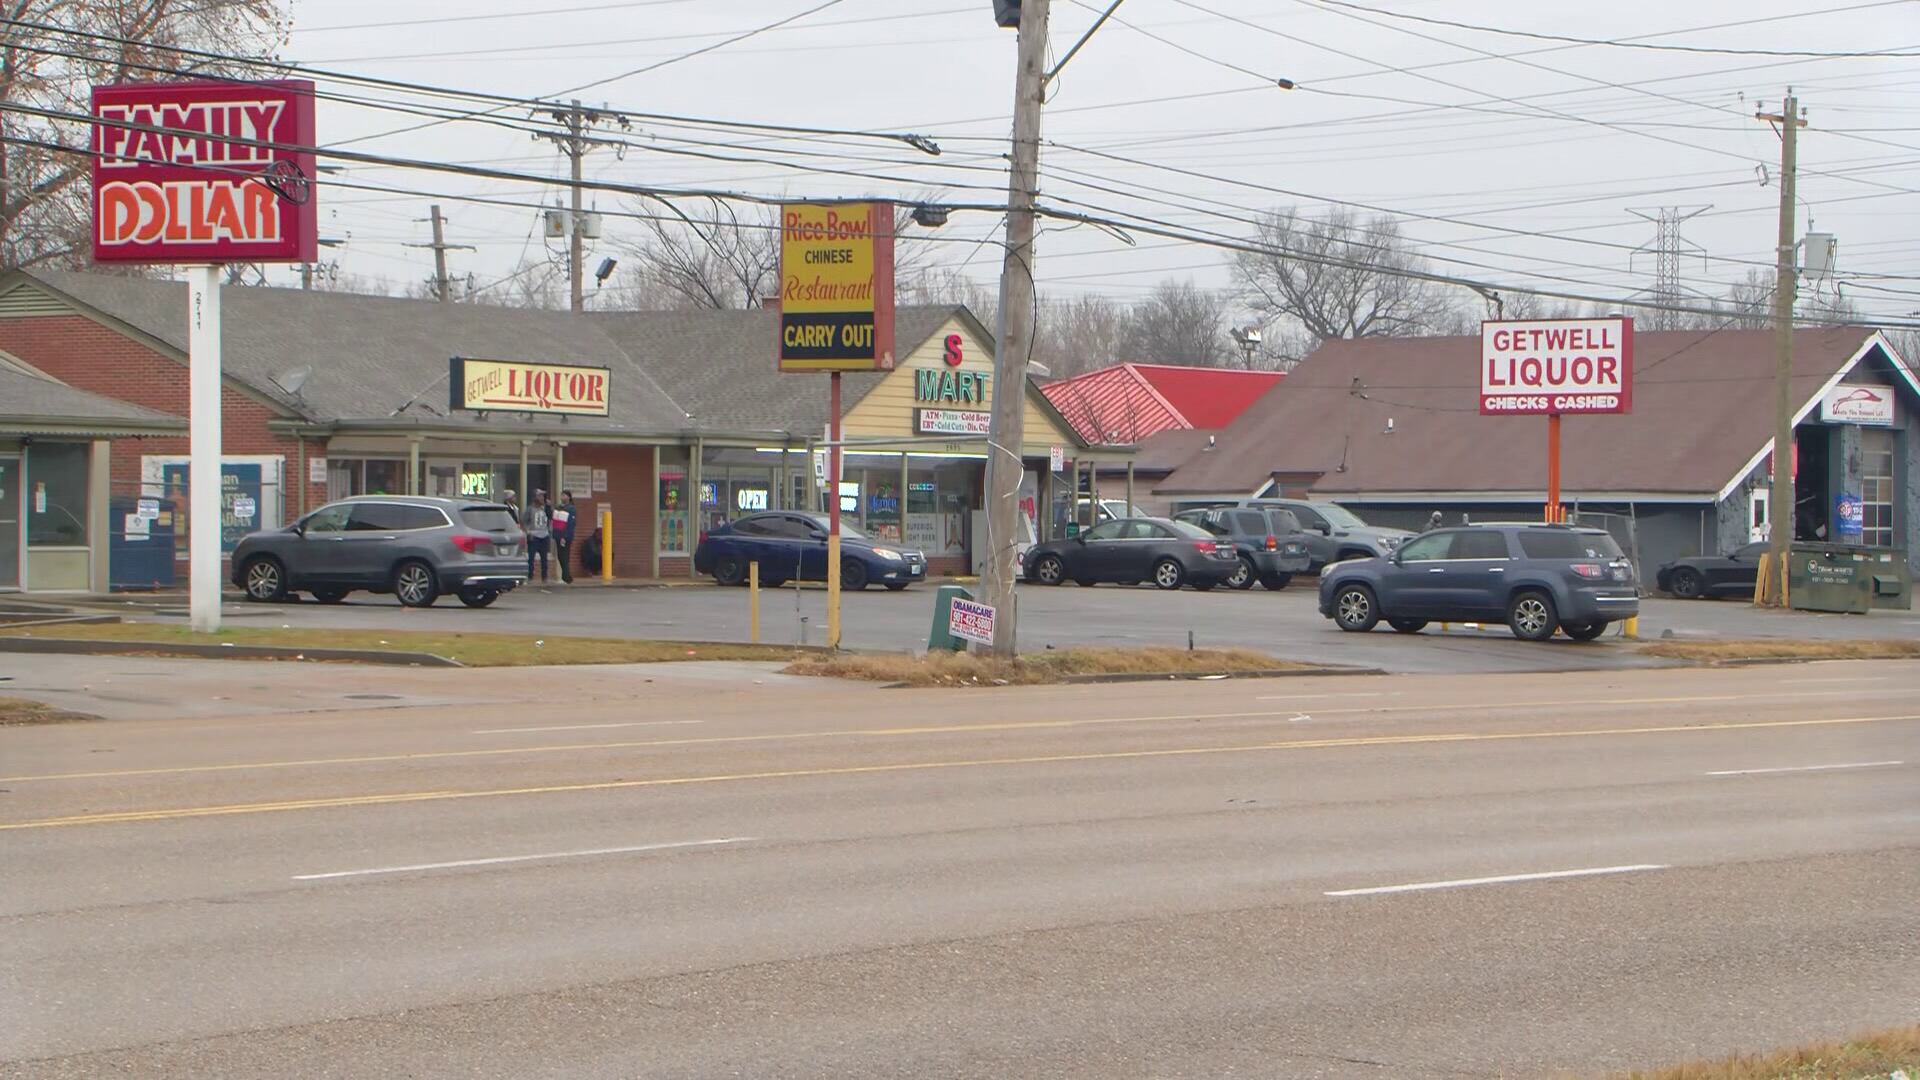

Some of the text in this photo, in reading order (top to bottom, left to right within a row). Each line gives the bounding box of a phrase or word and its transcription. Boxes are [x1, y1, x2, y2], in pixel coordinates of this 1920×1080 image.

[100, 101, 286, 168] FAMILY
[100, 179, 280, 245] DOLLAR
[786, 209, 872, 242] Rice Bowl
[805, 249, 853, 264] CHINESE
[784, 274, 874, 301] Restaurant
[784, 324, 874, 348] CARRY OUT
[1493, 328, 1615, 352] GETWELL
[945, 334, 963, 367] S
[917, 368, 991, 402] MART
[1488, 356, 1618, 387] LIQUOR
[467, 368, 605, 409] GETWELL LIQUOR
[1485, 395, 1619, 410] CHECKS CASHED
[925, 411, 940, 420] ATM
[961, 413, 975, 422] Cold
[738, 489, 768, 510] OPEN
[953, 601, 993, 618] OBAMACARE
